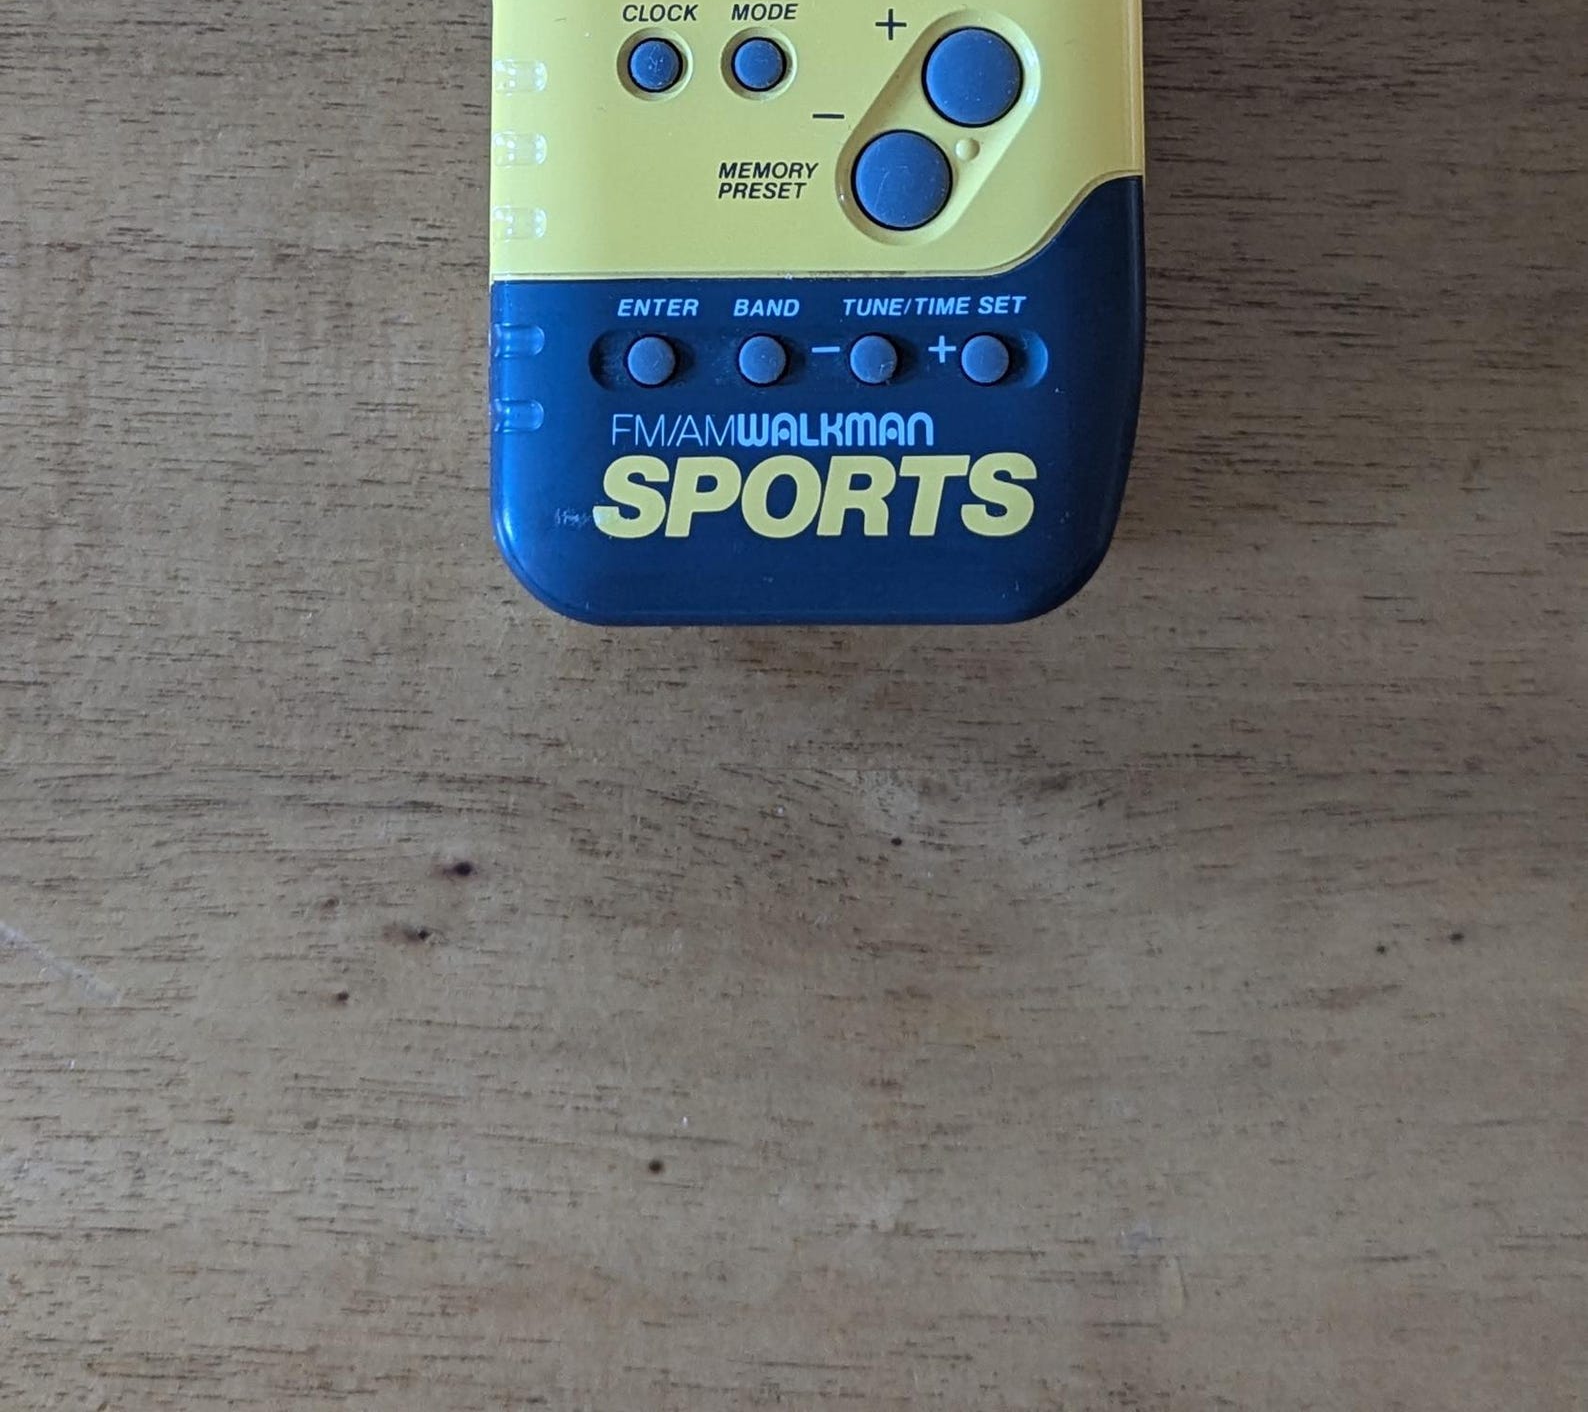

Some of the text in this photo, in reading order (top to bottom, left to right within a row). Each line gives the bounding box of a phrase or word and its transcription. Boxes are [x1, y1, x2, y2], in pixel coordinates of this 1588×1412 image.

[622, 4, 698, 22] CLOCK
[731, 4, 798, 21] MODE
[719, 162, 818, 180] MEMORY
[718, 182, 806, 200] PRESET
[617, 299, 699, 317] ENTER
[733, 299, 799, 316] BAND
[843, 296, 1026, 316] TUNE/TIME SET
[592, 453, 1036, 538] SPORTS
